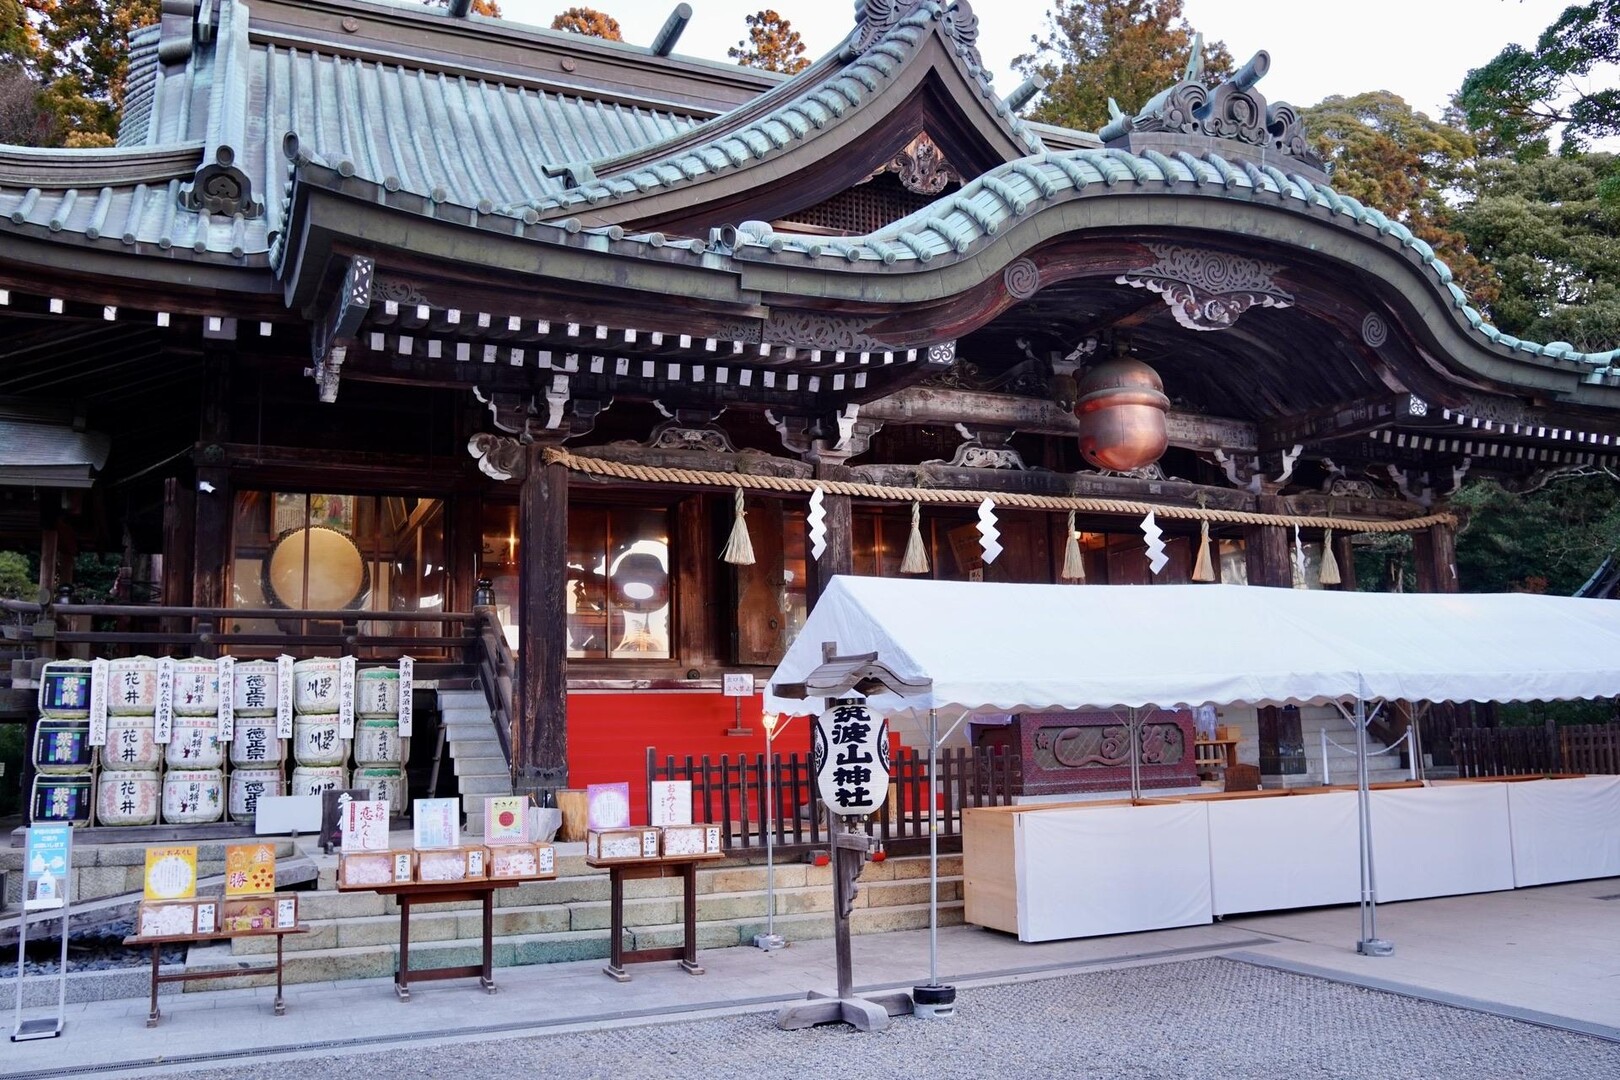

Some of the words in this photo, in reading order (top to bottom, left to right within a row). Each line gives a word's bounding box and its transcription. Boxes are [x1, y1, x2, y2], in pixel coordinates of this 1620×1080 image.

[124, 672, 140, 704] 花の井
[194, 675, 206, 704] 副将軍
[246, 675, 267, 707] 徳正宗
[122, 730, 138, 762] 花の井
[191, 729, 203, 759] 副将軍
[246, 728, 267, 760] 徳正宗
[832, 706, 873, 807] 筑波山神社
[120, 781, 136, 814] 花の井
[188, 782, 200, 813] 副将軍
[245, 780, 262, 812] 徳正宗
[666, 784, 677, 822] おみくじ
[360, 806, 374, 849] 恋みくじ
